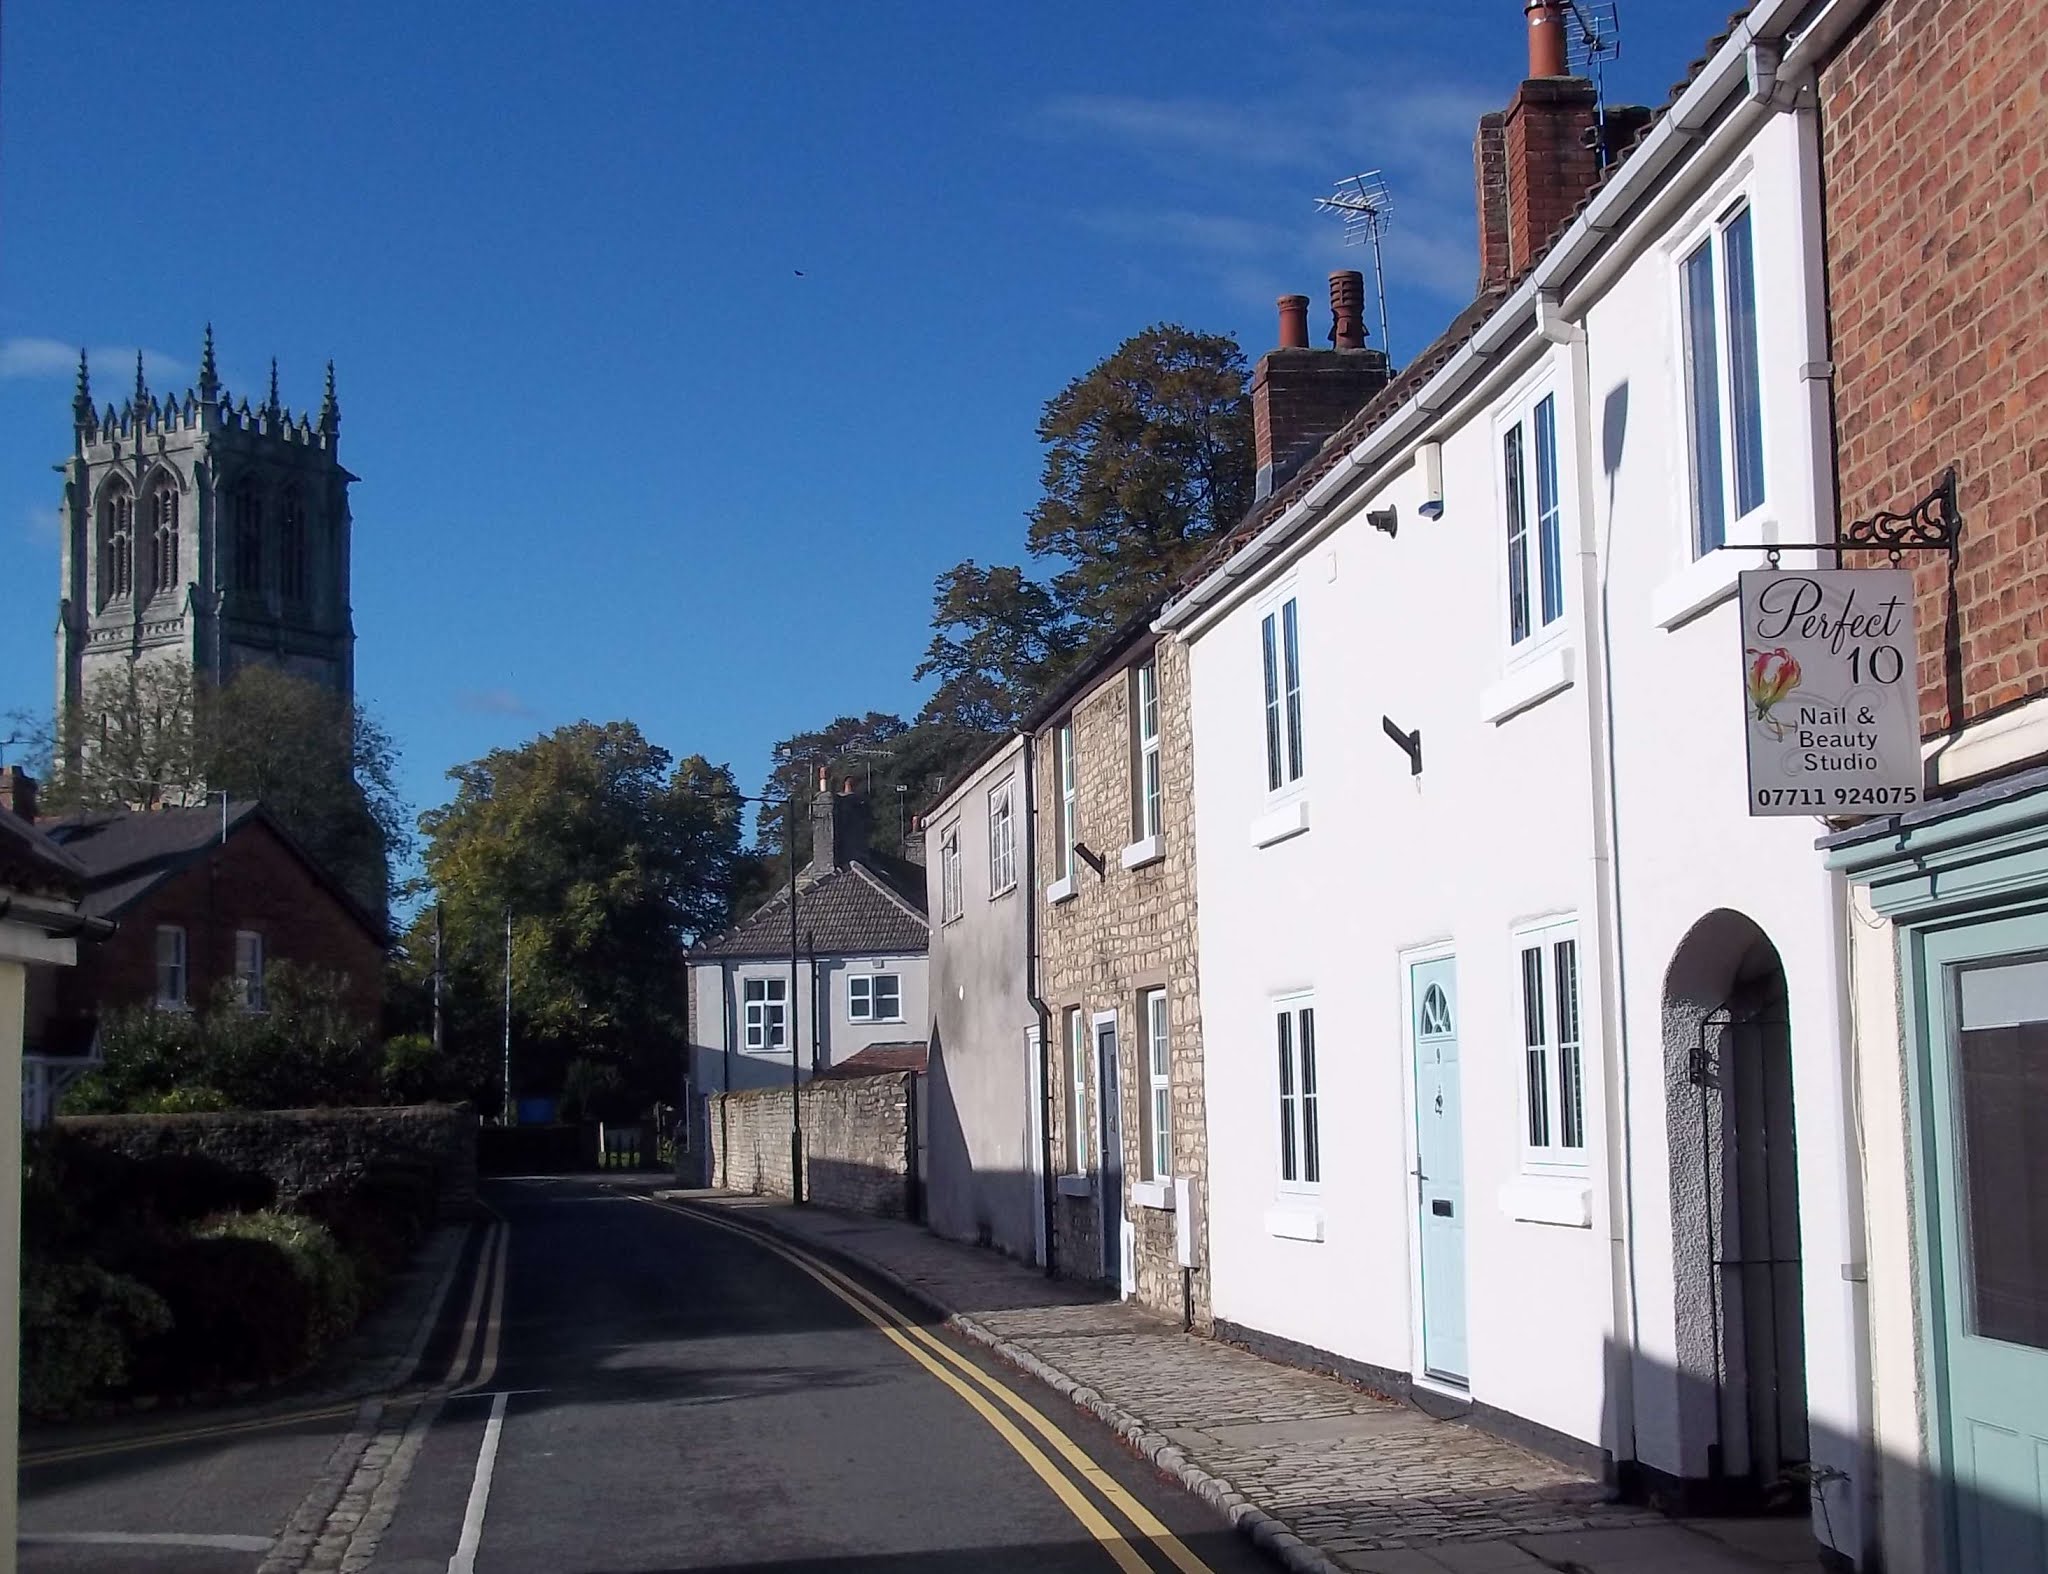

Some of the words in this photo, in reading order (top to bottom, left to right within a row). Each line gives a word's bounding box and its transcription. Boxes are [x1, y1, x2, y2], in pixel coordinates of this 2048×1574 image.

[1757, 577, 1906, 655] Perfect
[1846, 645, 1904, 684] 10
[1800, 707, 1846, 725] Nail
[1857, 706, 1875, 724] &
[1800, 730, 1877, 750] Beauty
[1804, 753, 1877, 771] Studio
[1758, 788, 1826, 806] 07711
[1834, 787, 1916, 804] 924075
